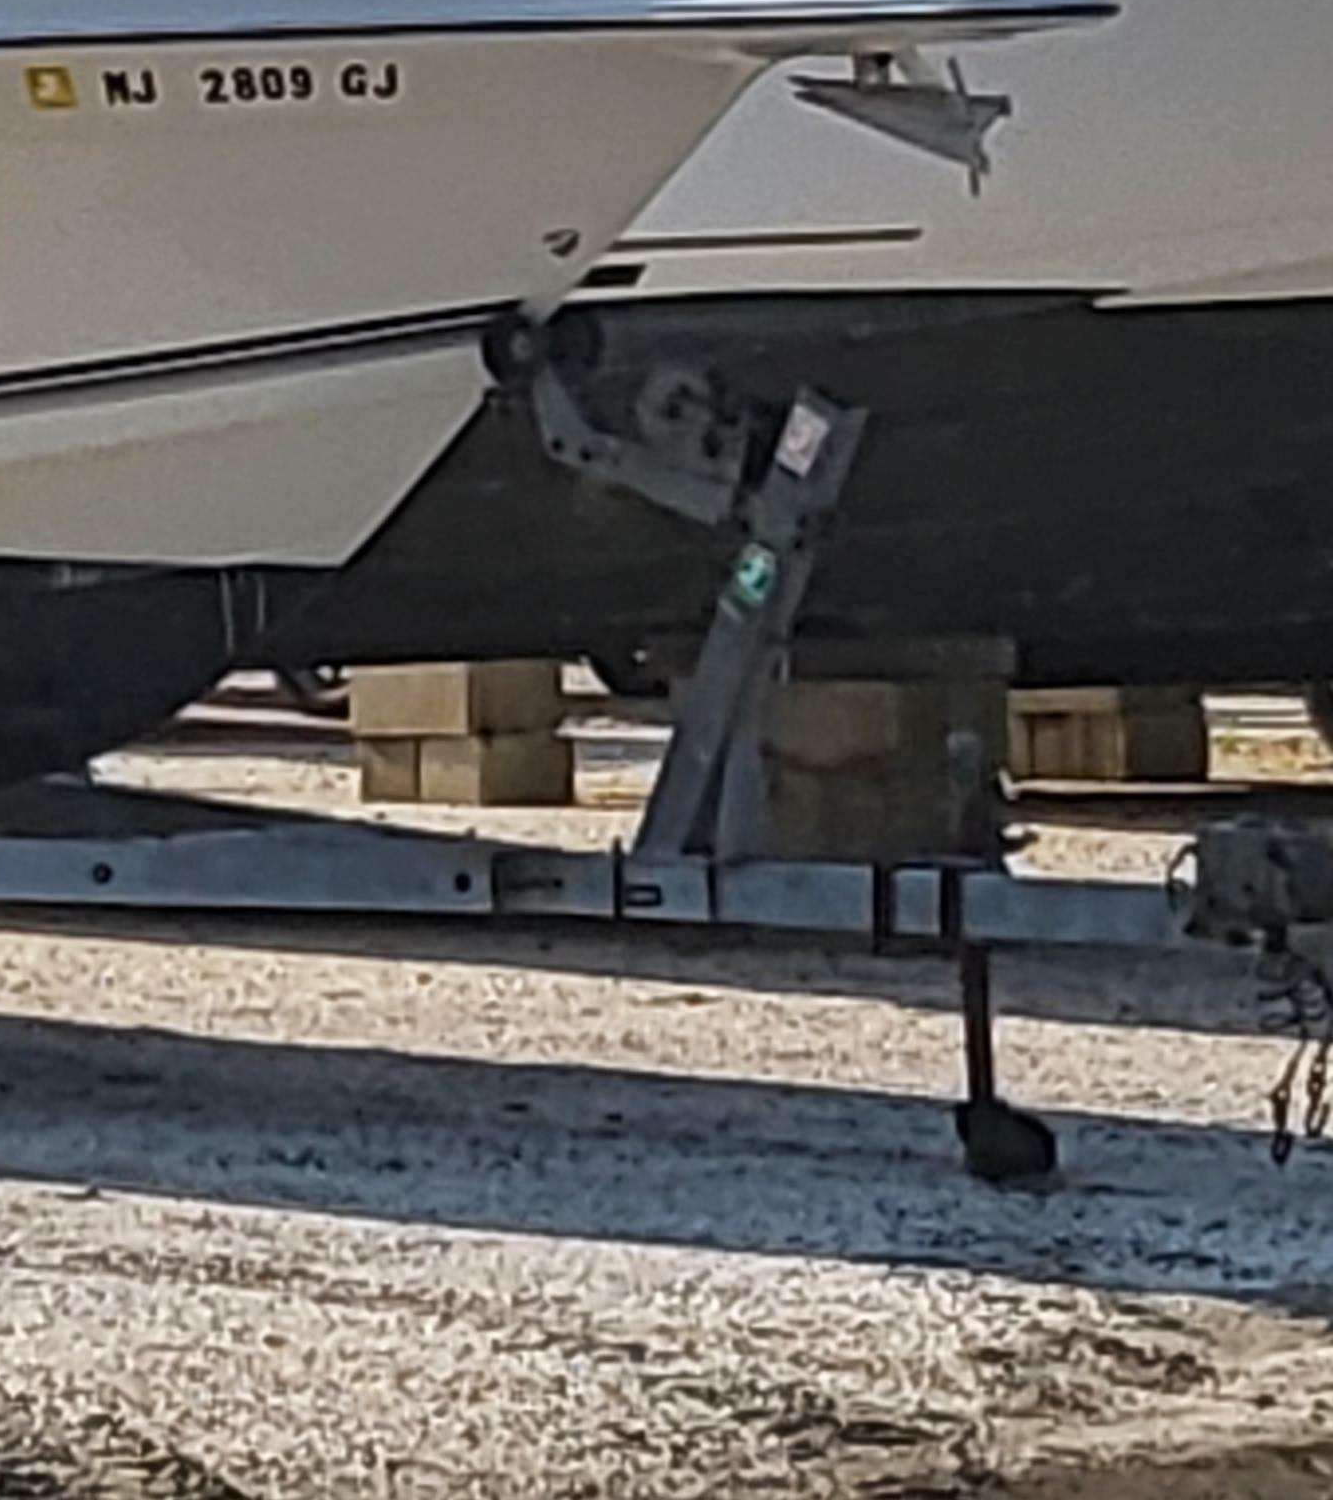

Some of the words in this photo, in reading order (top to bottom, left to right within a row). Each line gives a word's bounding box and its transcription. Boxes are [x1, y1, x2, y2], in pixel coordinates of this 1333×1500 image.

[102, 69, 158, 106] NJ
[199, 65, 313, 104] 2809
[339, 62, 398, 100] GJ
